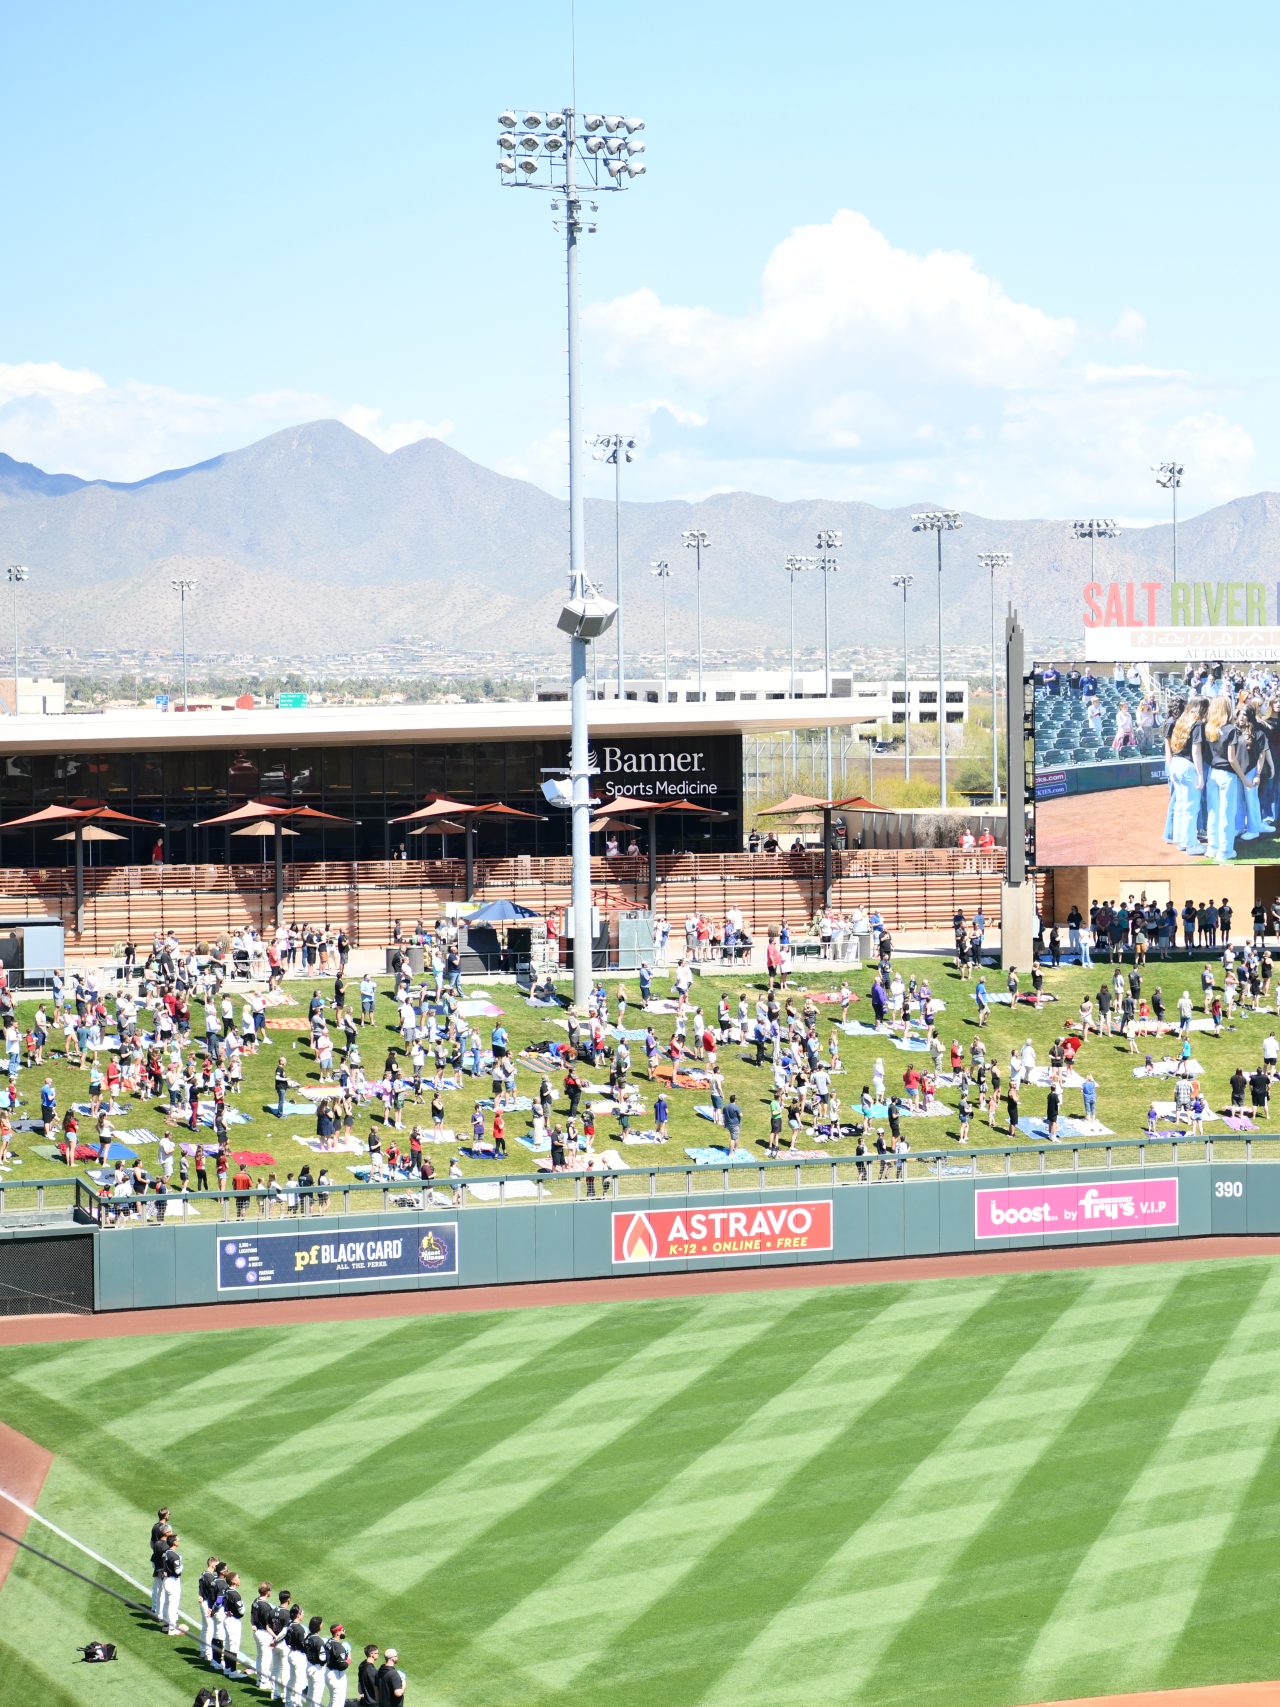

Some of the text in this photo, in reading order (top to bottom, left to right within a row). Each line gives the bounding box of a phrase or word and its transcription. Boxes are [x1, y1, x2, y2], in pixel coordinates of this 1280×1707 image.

[1082, 581, 1162, 627] SALT
[1171, 581, 1267, 626] RIVER
[1184, 648, 1200, 658] AT
[1204, 648, 1254, 658] TALKING
[606, 780, 718, 798] Sports Medicine
[1215, 1182, 1243, 1198] 390
[1064, 1208, 1078, 1221] by
[1078, 1188, 1135, 1220] fry's
[667, 1208, 812, 1242] ASTRAVO
[294, 1240, 402, 1271] pf BLACK CARD
[669, 1236, 808, 1255] K-12 ONLINE FREE
